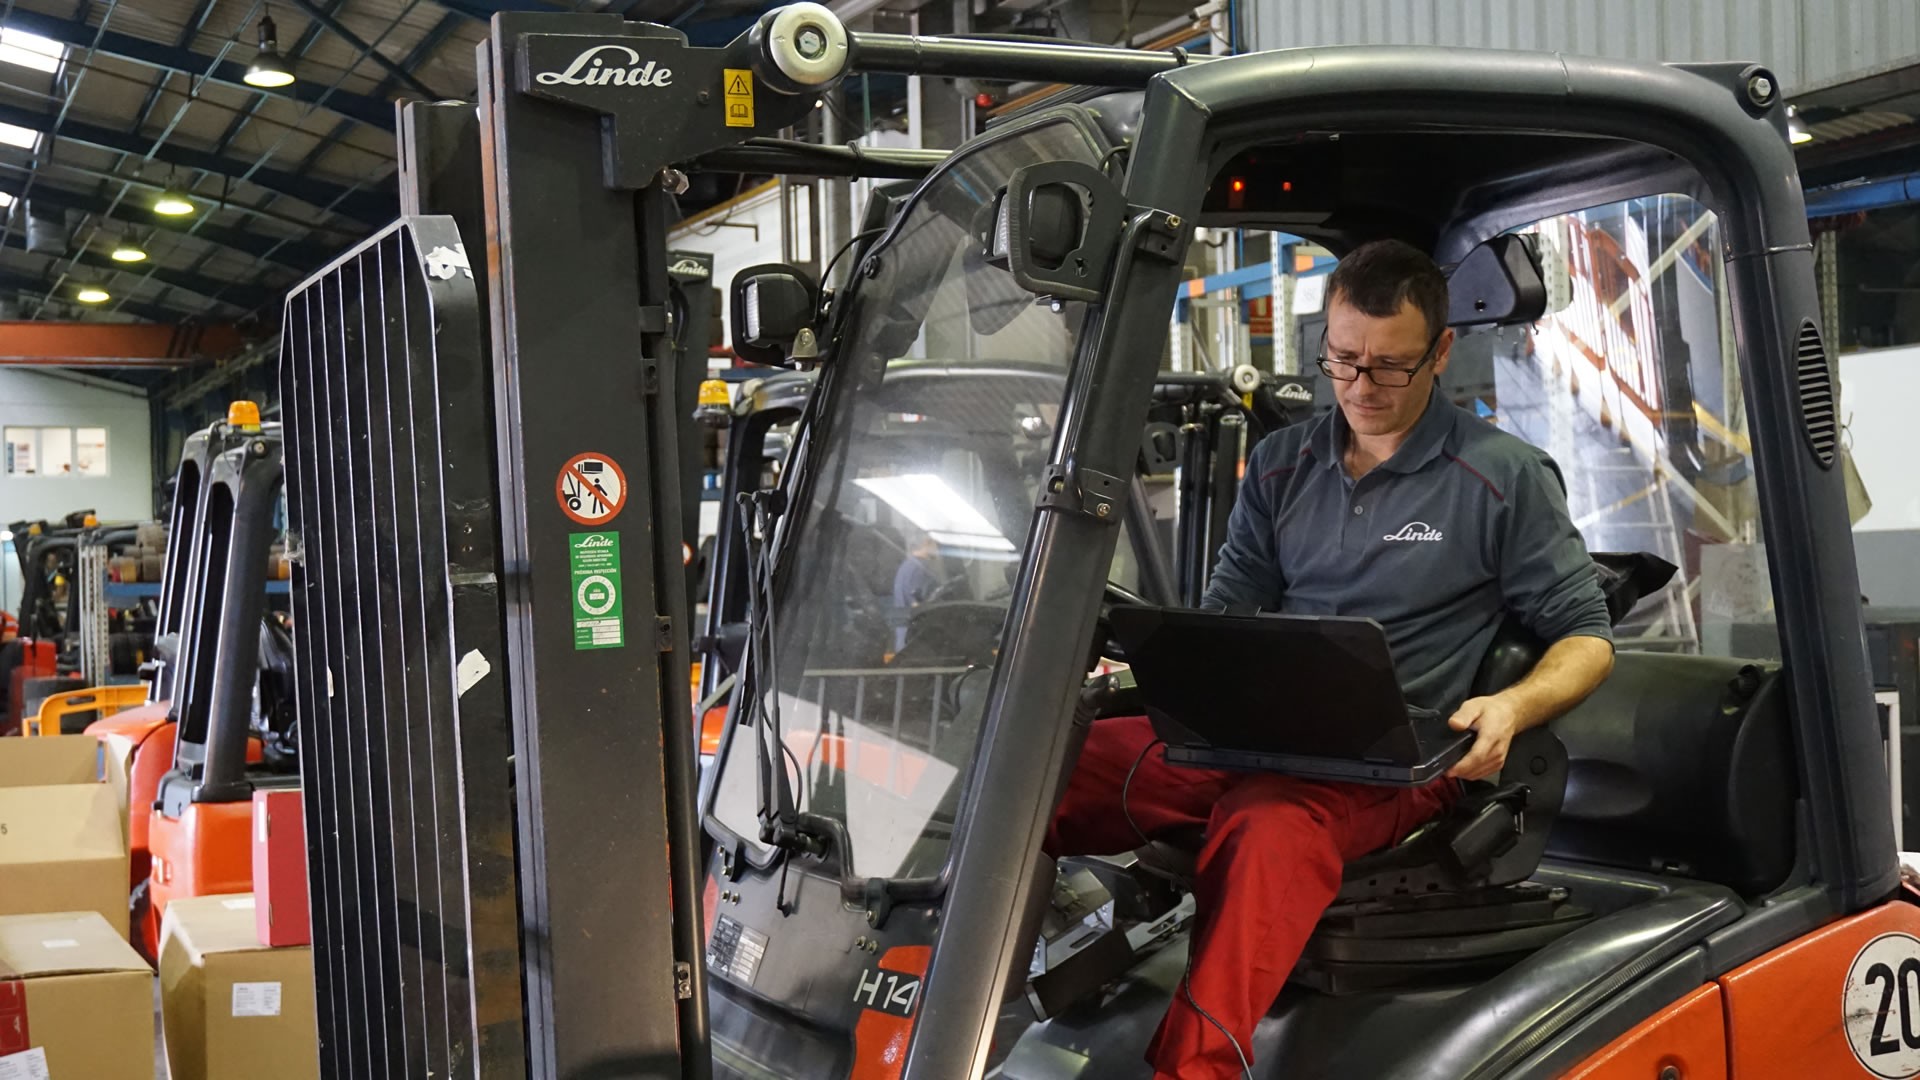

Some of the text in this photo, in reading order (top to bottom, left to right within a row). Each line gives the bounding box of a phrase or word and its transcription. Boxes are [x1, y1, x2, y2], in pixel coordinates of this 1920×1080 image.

[536, 45, 672, 87] Linde
[574, 534, 613, 548] Linde
[1383, 521, 1443, 541] Linde
[1865, 957, 1920, 1056] 20
